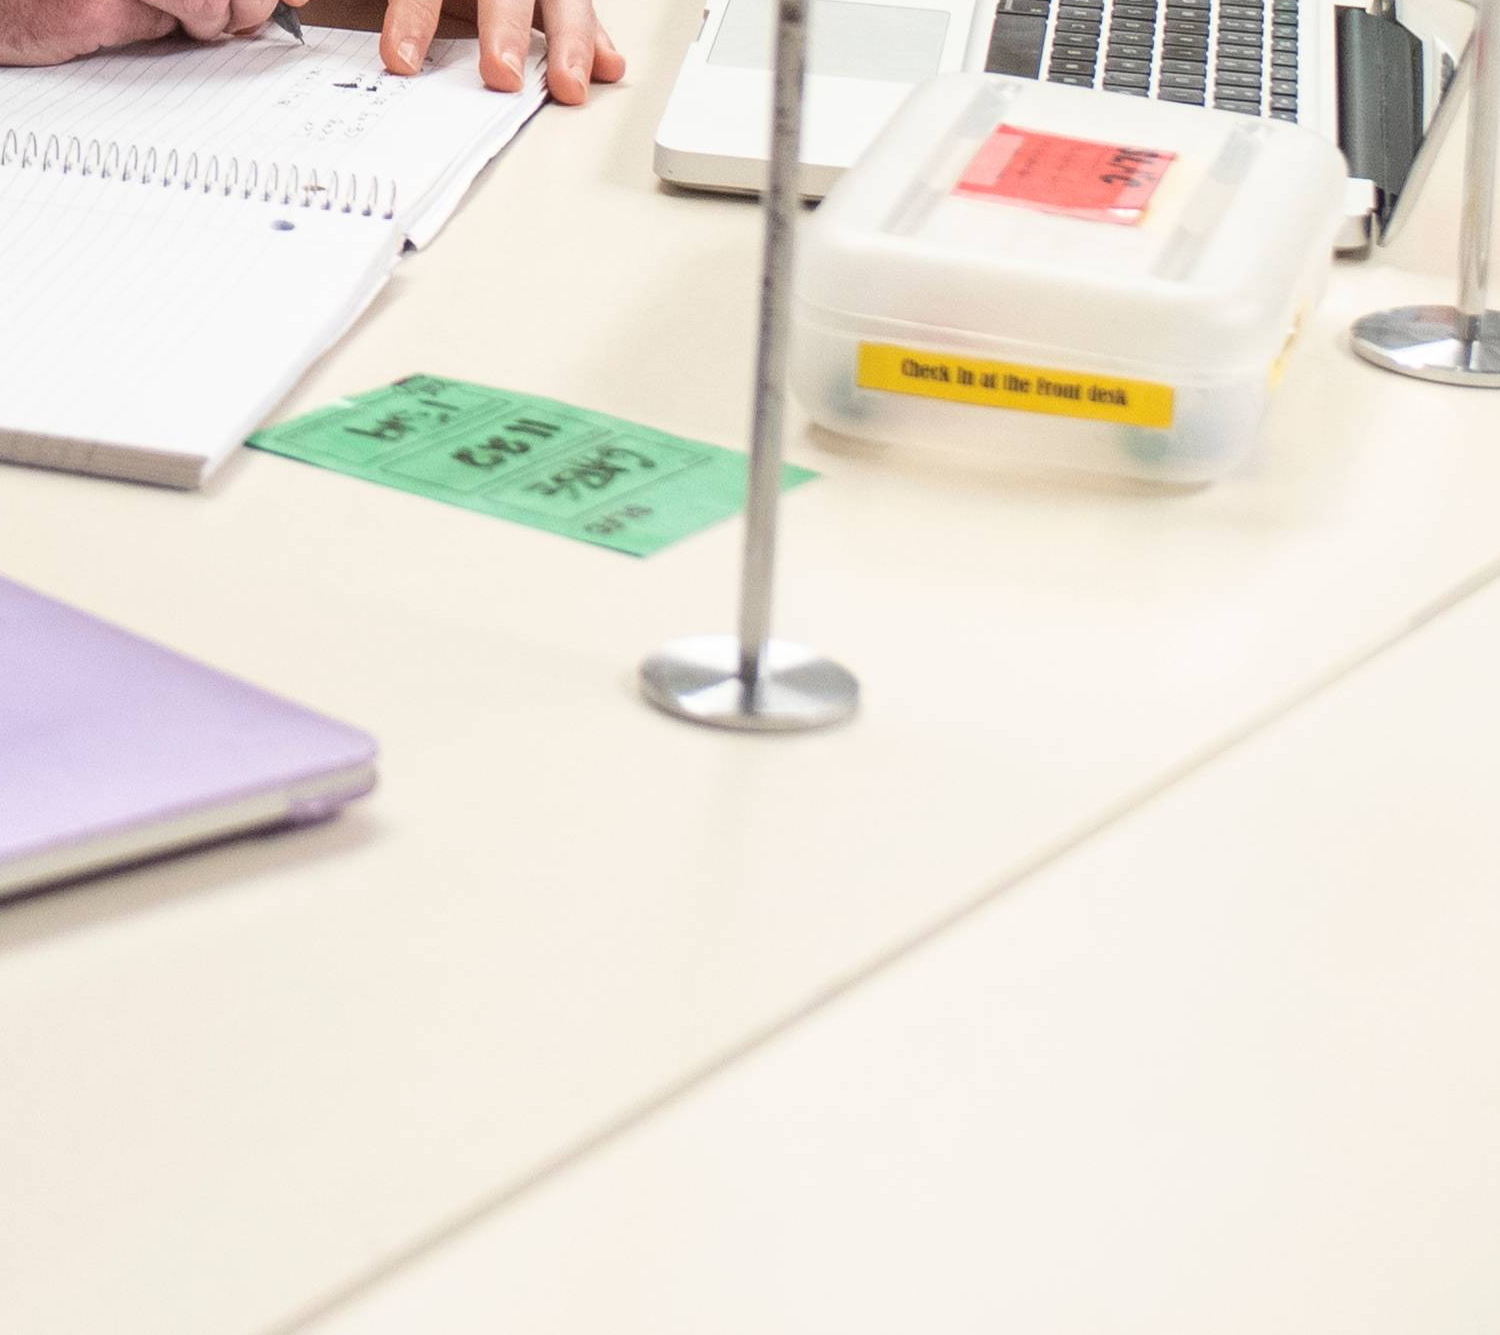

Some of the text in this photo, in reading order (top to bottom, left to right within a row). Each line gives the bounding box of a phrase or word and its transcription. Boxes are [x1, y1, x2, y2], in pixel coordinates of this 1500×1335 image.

[901, 358, 949, 382] Check
[980, 371, 997, 388] at
[1003, 373, 1030, 393] the
[1087, 384, 1127, 406] desk
